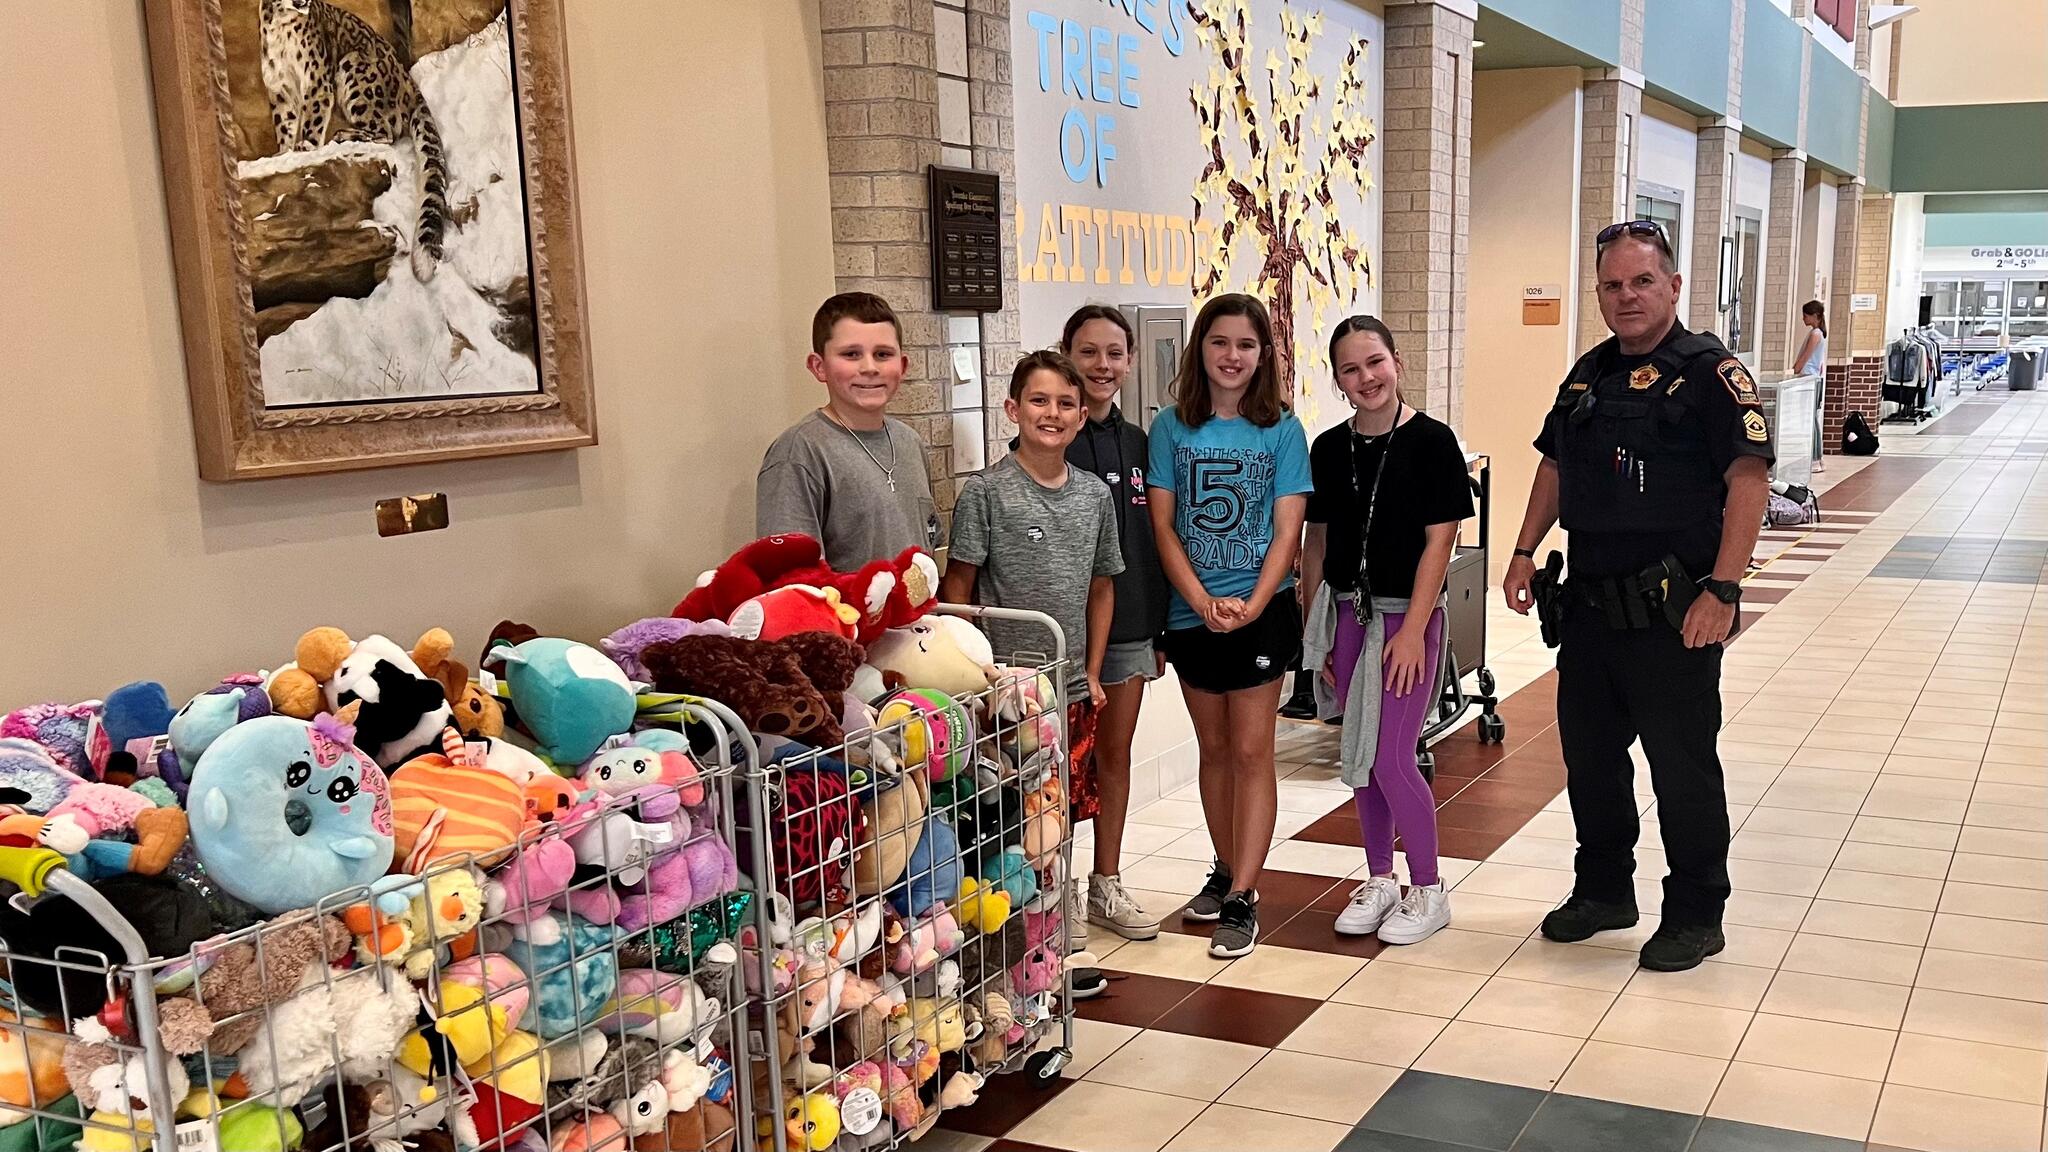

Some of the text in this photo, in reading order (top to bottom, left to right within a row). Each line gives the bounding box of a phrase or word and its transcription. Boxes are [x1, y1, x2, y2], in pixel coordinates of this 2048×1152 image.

[1028, 11, 1141, 108] TREE
[1060, 106, 1117, 188] OF
[1971, 248, 2002, 258] Grab
[2004, 247, 2013, 258] &
[2014, 248, 2033, 258] GO
[1526, 287, 1542, 295] 1026
[1190, 458, 1245, 534] 5
[1187, 536, 1269, 570] RADE
